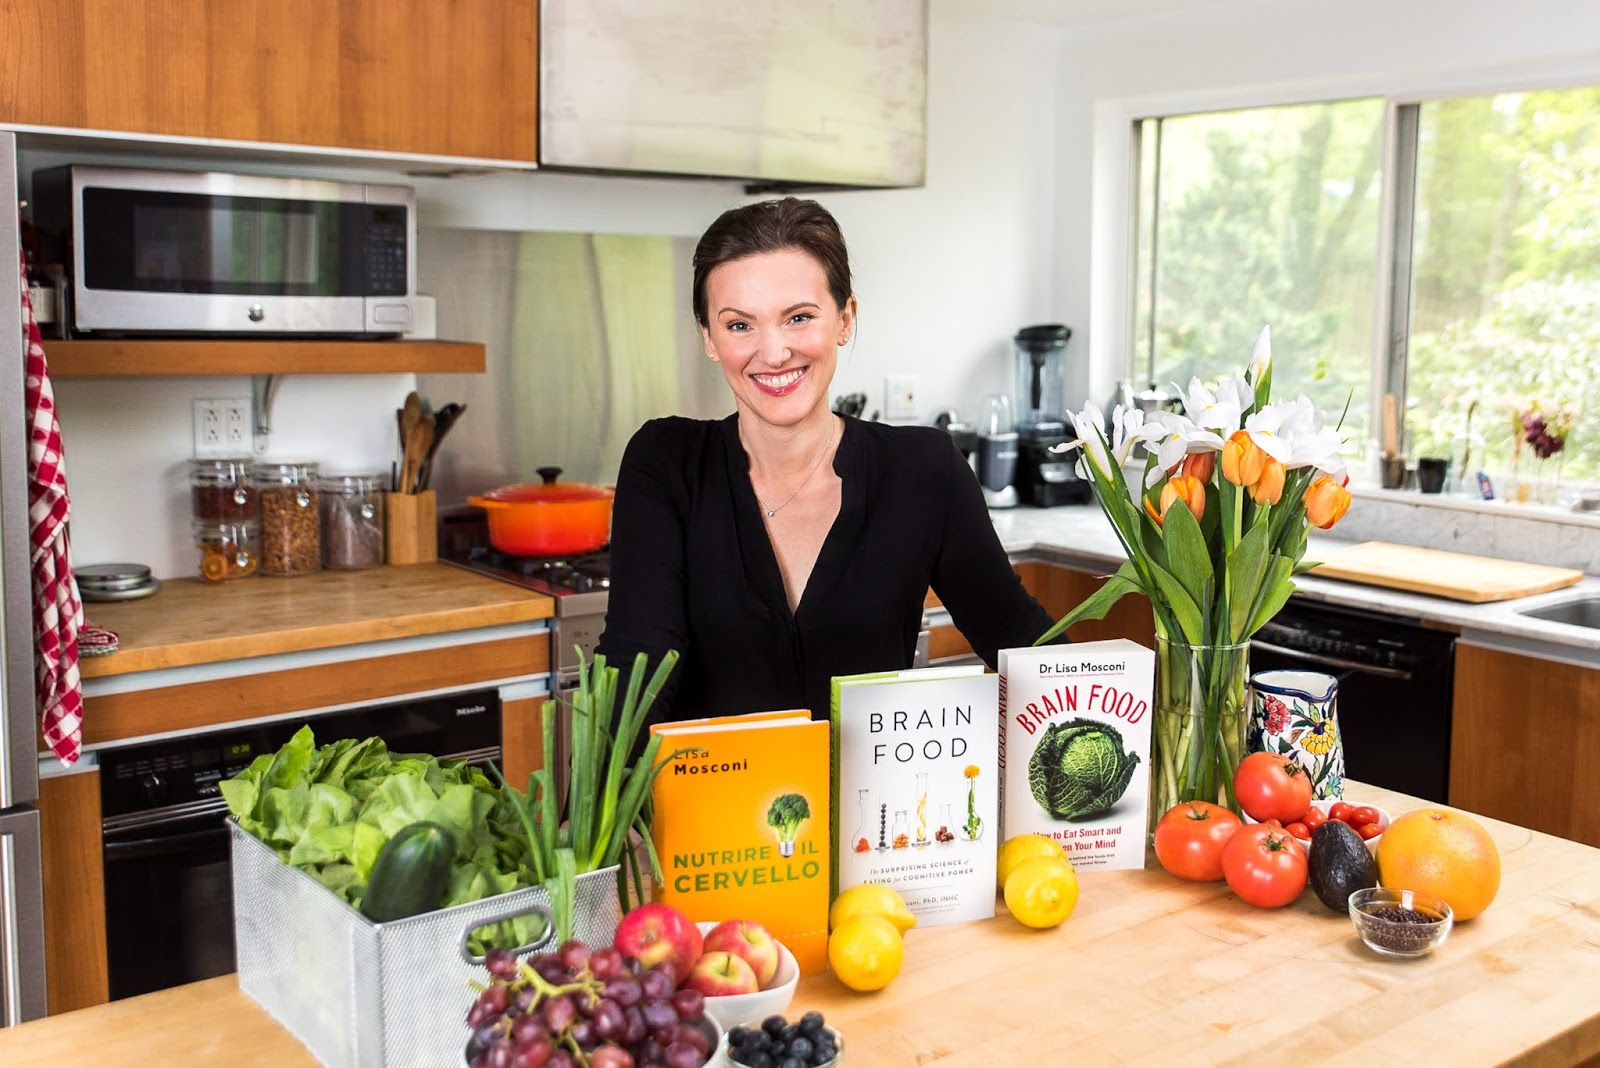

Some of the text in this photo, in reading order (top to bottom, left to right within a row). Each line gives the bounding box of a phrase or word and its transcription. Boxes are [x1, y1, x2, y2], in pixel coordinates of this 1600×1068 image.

[1039, 661, 1125, 674] Dr Lisa Mosconi
[998, 674, 1007, 719] BRAIN
[1015, 684, 1147, 735] BRAIN FOOD
[870, 705, 971, 765] BRAIN FOOD
[998, 724, 1006, 769] FOOD
[674, 758, 747, 775] Mosconi
[1053, 831, 1062, 840] to
[1063, 829, 1077, 839] Eat
[1079, 828, 1104, 838] Smart
[1106, 825, 1122, 836] and
[673, 841, 819, 869] NUTRIRE IL
[1074, 841, 1093, 851] Your
[1095, 839, 1116, 849] Mind
[674, 861, 820, 893] CERVELLO
[880, 863, 927, 874] SURPRISING
[930, 859, 962, 869] SCIENCE
[903, 871, 945, 882] COGNITIVE
[948, 868, 974, 877] POWER
